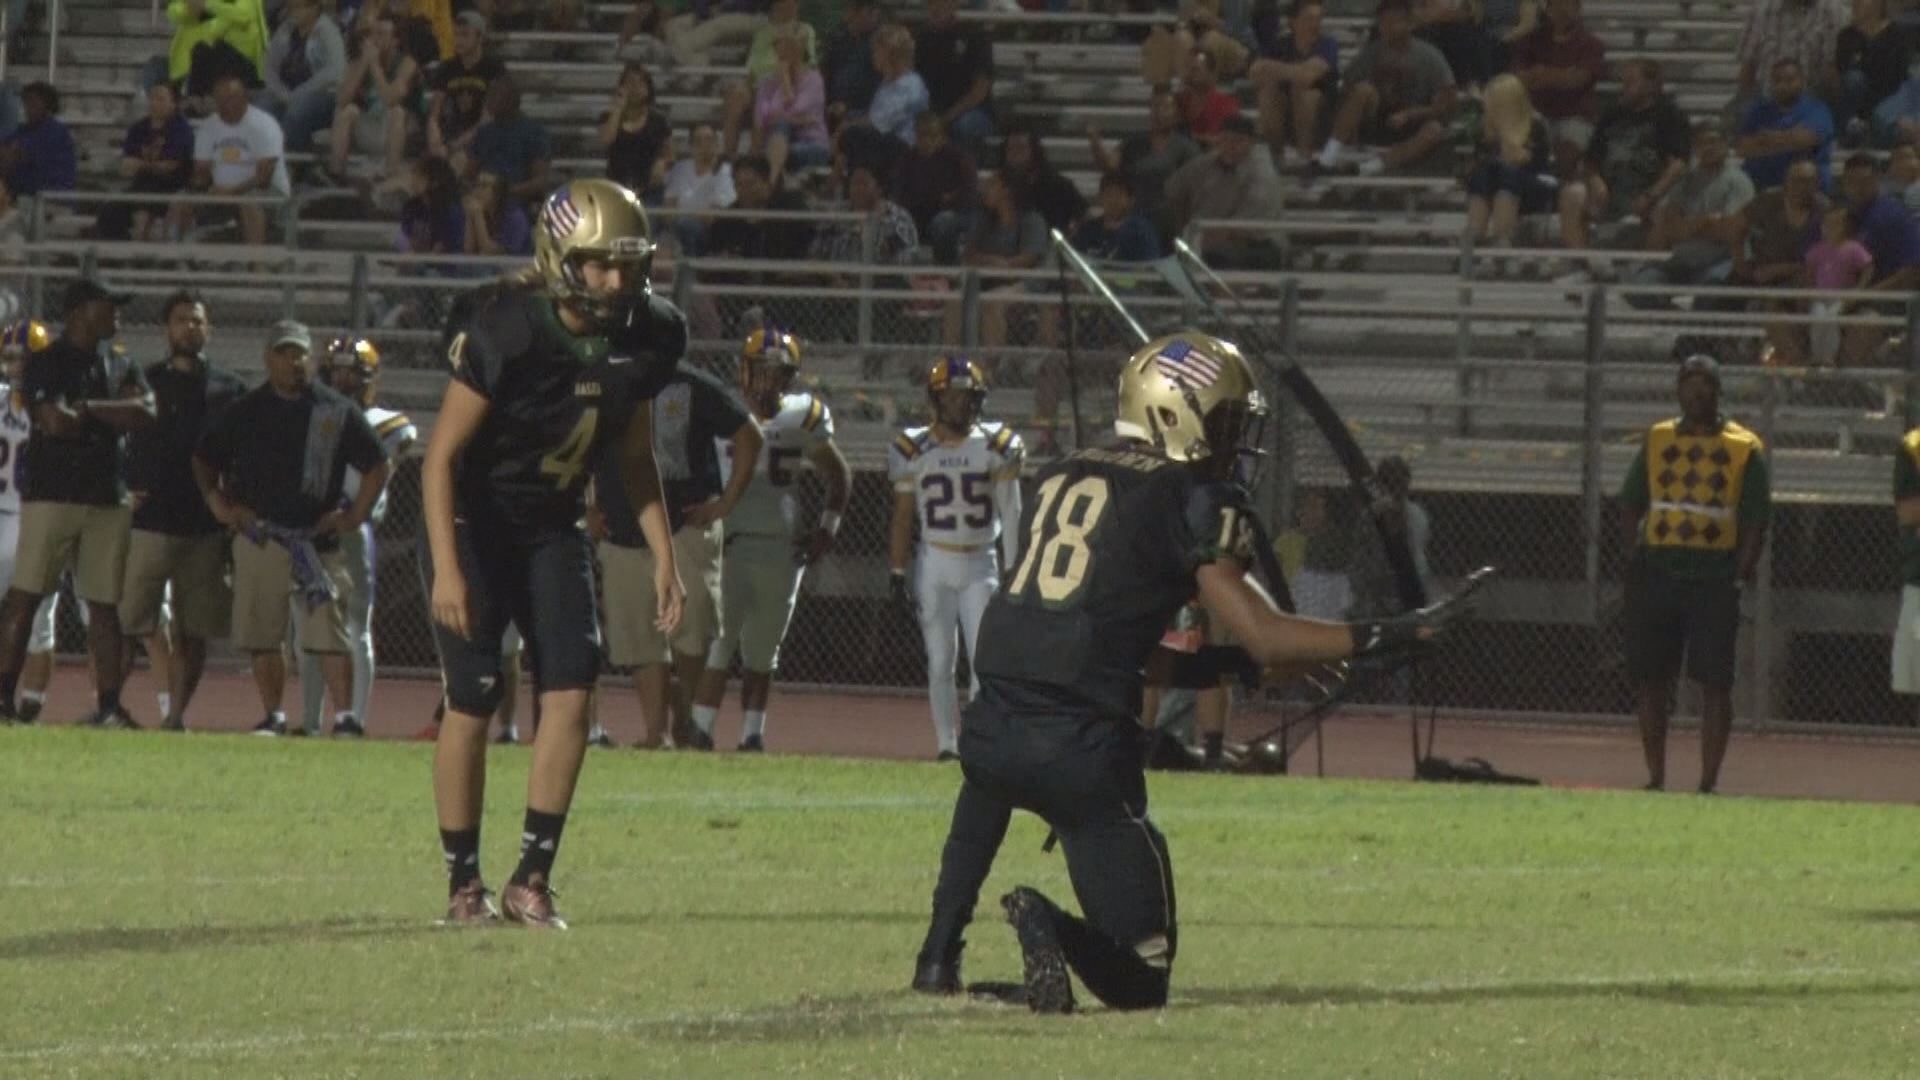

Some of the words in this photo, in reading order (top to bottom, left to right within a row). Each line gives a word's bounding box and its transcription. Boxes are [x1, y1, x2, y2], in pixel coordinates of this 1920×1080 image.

[448, 332, 466, 370] 4
[541, 407, 599, 491] 4
[921, 472, 992, 531] 25
[1009, 473, 1108, 601] 18
